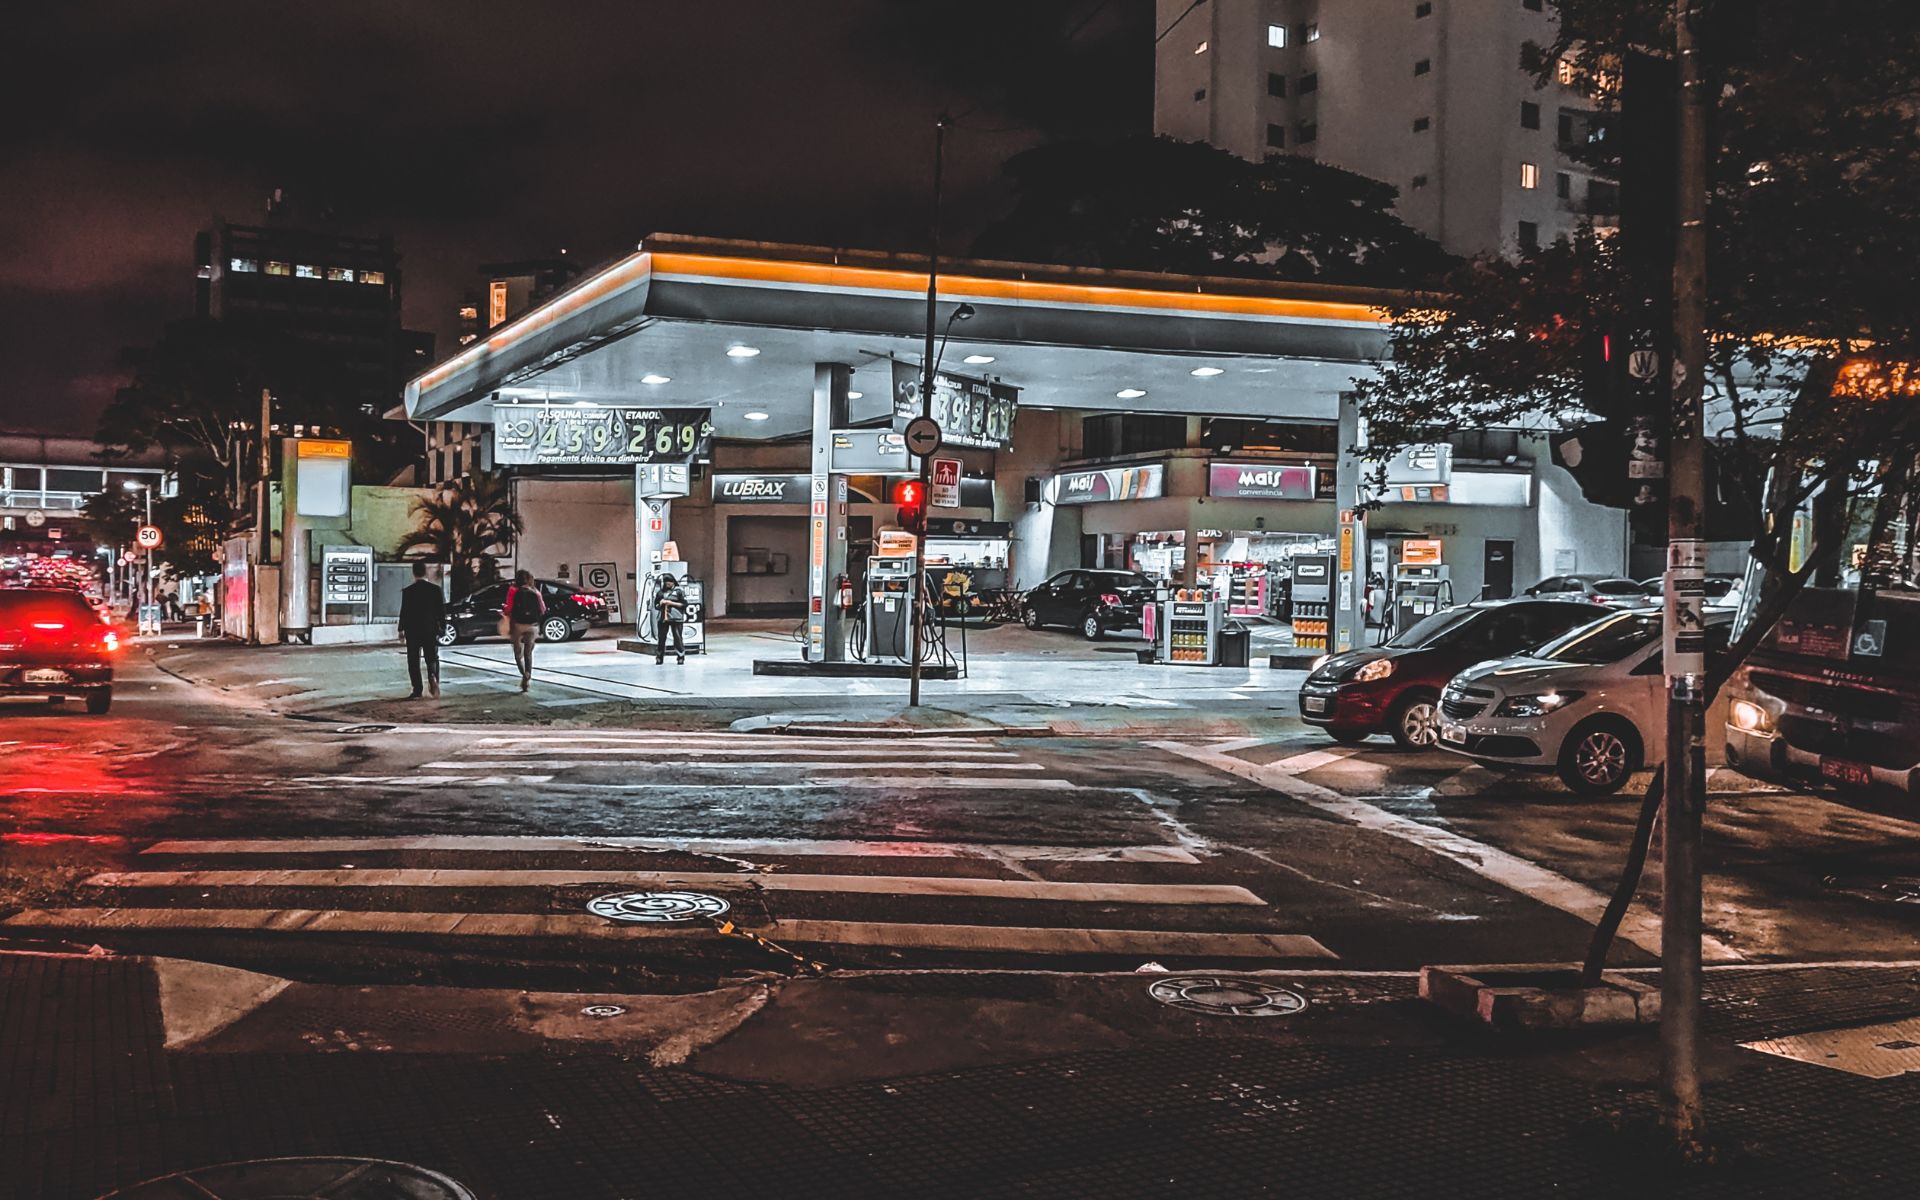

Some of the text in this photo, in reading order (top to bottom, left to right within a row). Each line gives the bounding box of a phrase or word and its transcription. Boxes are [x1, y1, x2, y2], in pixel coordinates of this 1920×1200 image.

[537, 411, 581, 420] GASOLINA
[626, 411, 660, 419] ETANOL
[537, 455, 579, 463] Pagamento
[618, 454, 649, 463] dinheiro
[723, 482, 786, 496] LUBRAX
[141, 531, 156, 540] 50
[594, 571, 605, 584] E
